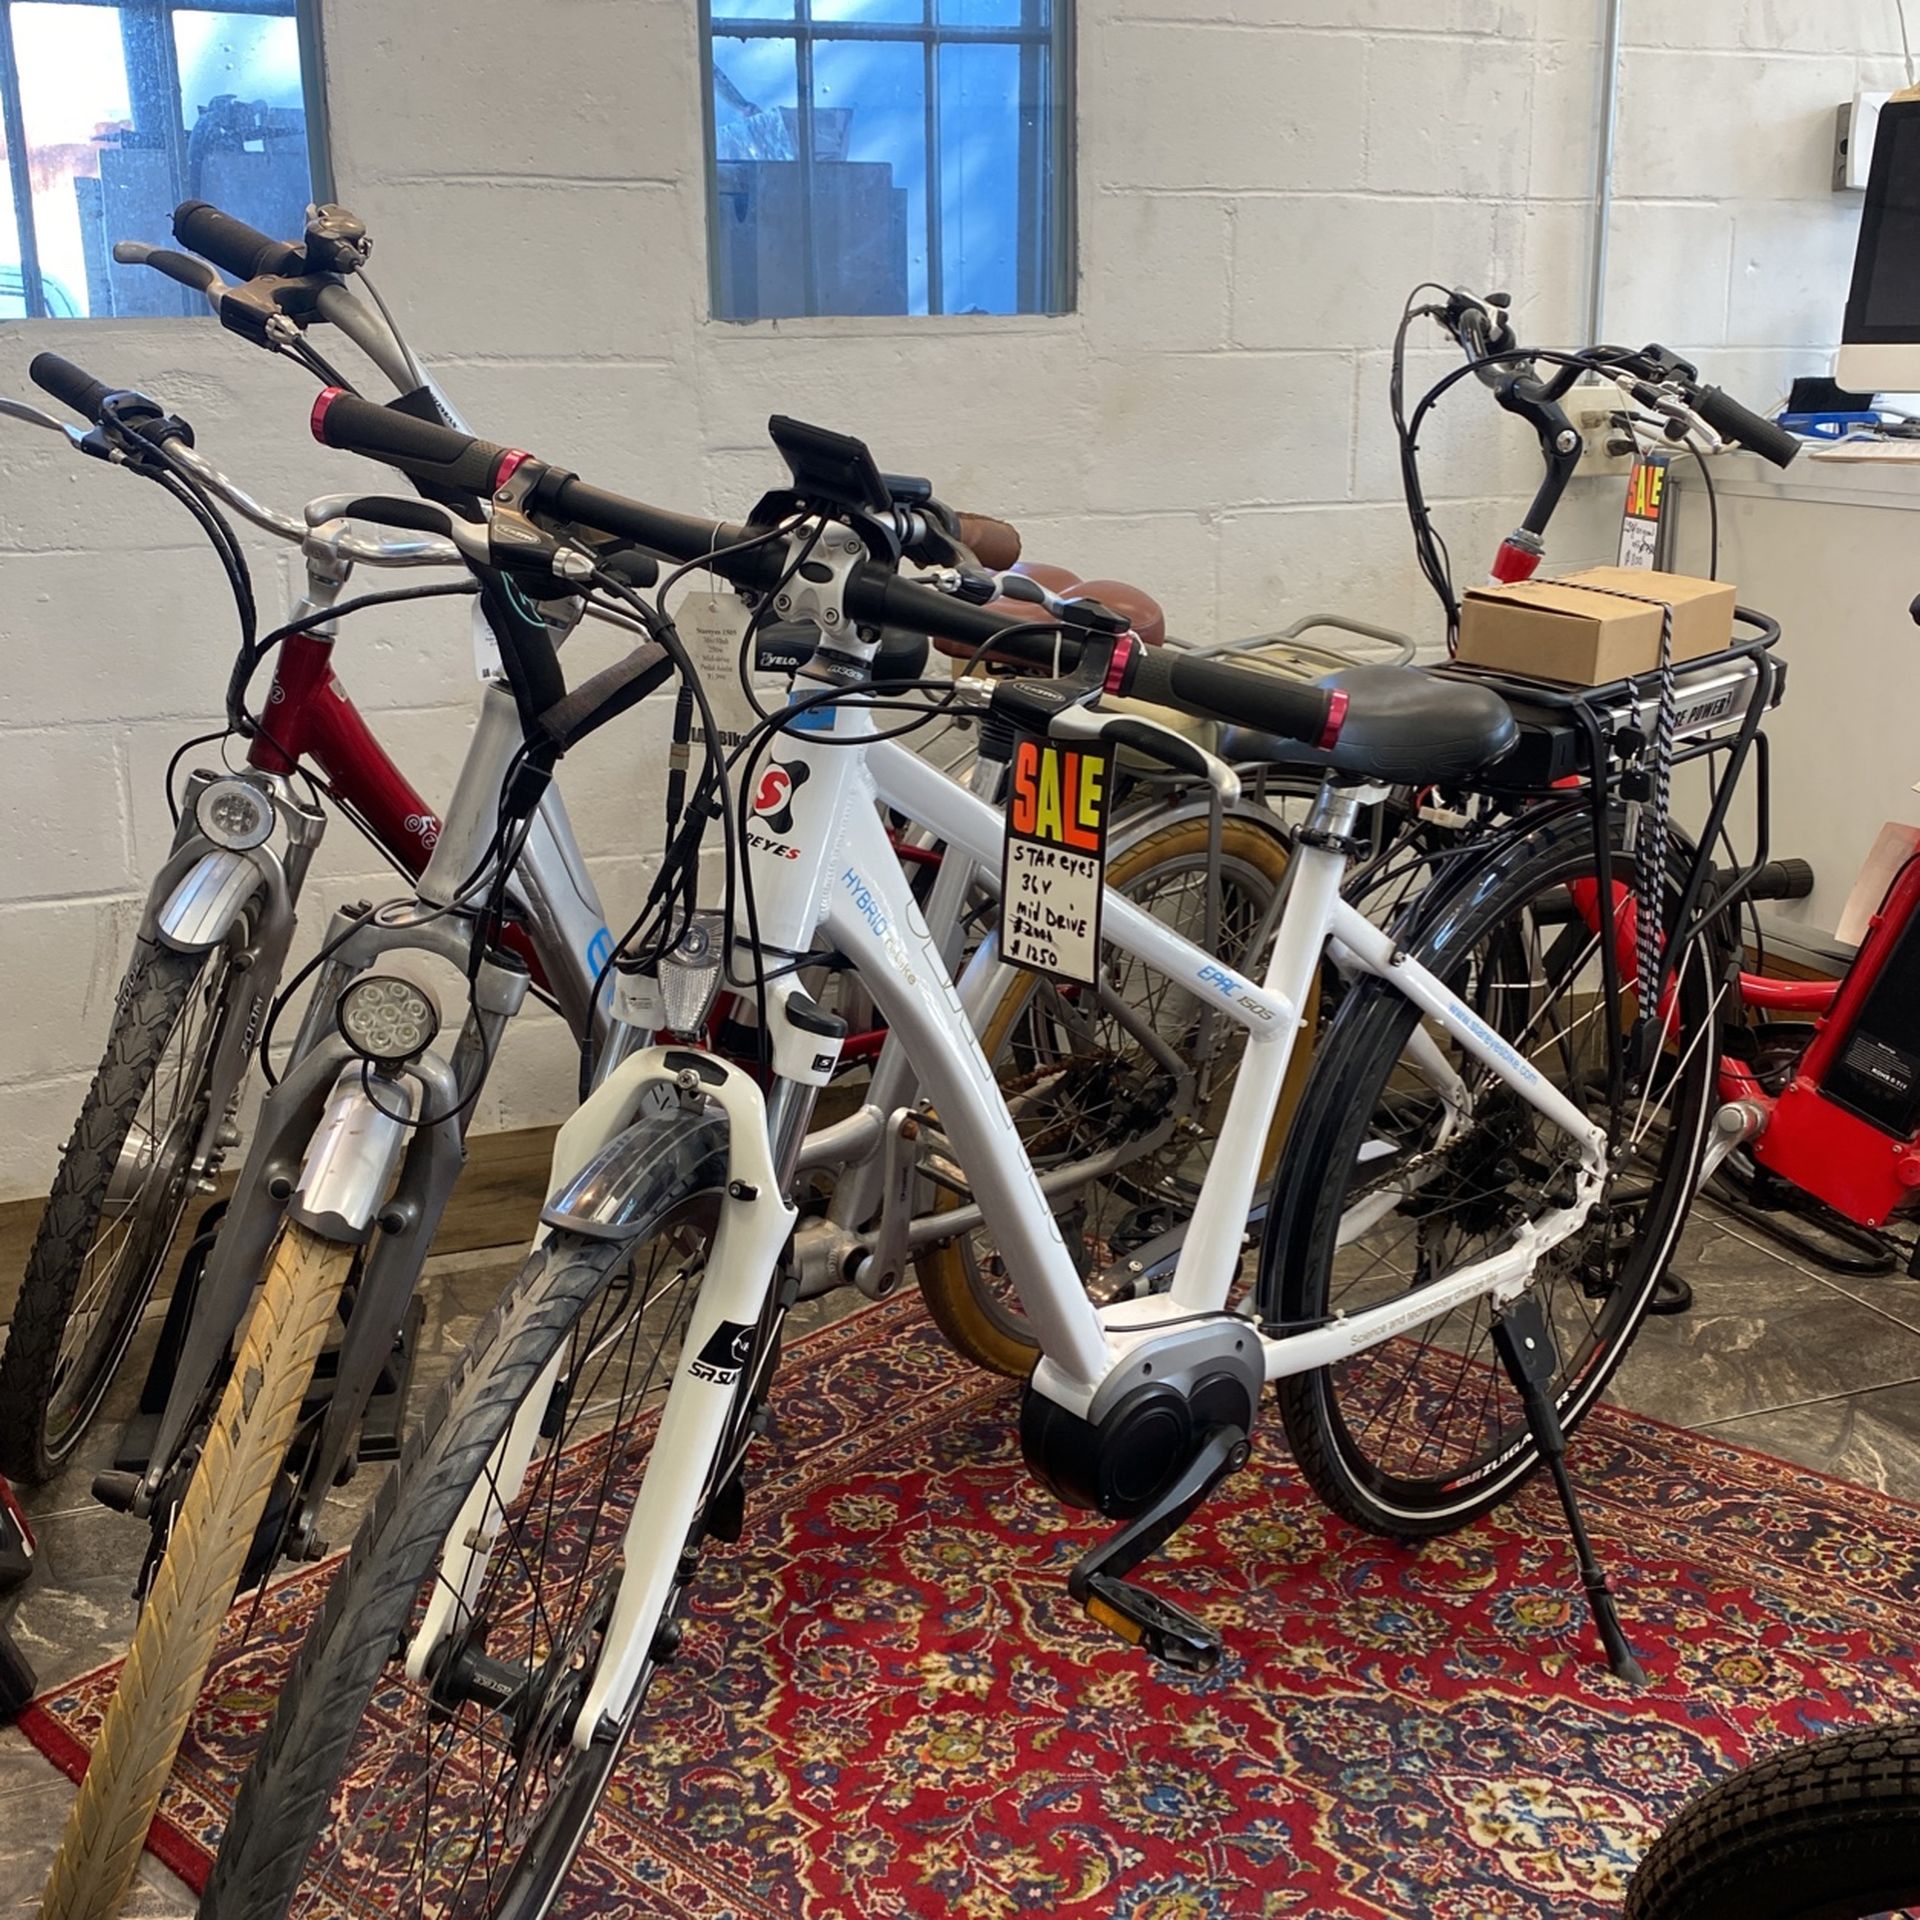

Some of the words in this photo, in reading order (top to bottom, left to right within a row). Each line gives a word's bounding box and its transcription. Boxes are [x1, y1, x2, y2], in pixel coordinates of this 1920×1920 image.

[1627, 464, 1665, 518] SALE
[769, 656, 797, 666] VELO
[1013, 742, 1105, 850] SALE
[841, 867, 889, 937] HYBRID
[1196, 965, 1242, 998] EPAC
[1350, 1324, 1388, 1346] Science
[1388, 1312, 1406, 1330] and
[1407, 1295, 1451, 1323] technology
